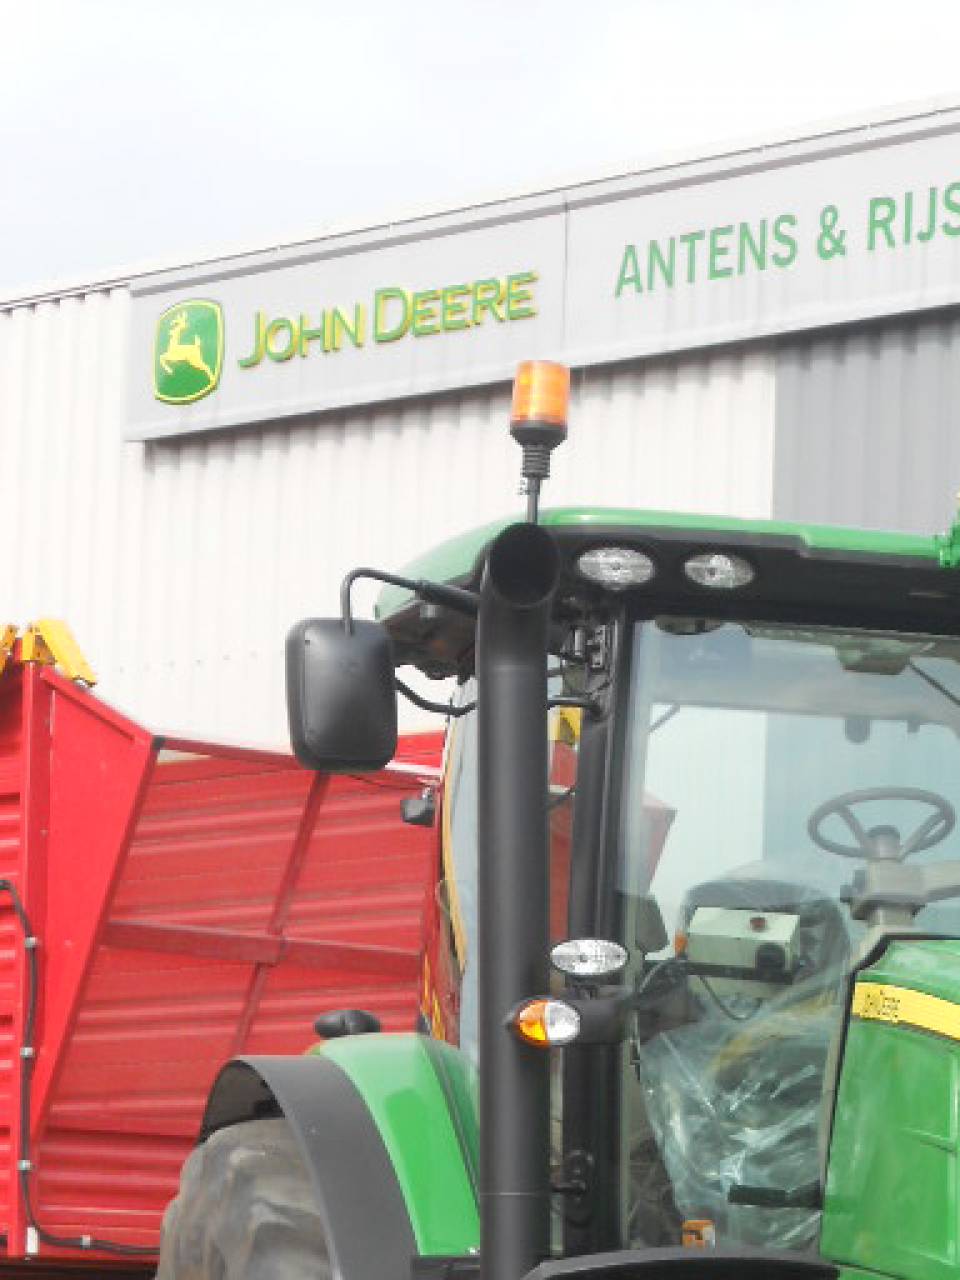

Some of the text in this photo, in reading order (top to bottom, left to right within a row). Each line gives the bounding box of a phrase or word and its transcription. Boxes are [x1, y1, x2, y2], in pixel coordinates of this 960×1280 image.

[615, 213, 799, 298] ANTENS
[816, 203, 847, 261] &
[238, 272, 538, 369] JOHN DEERE
